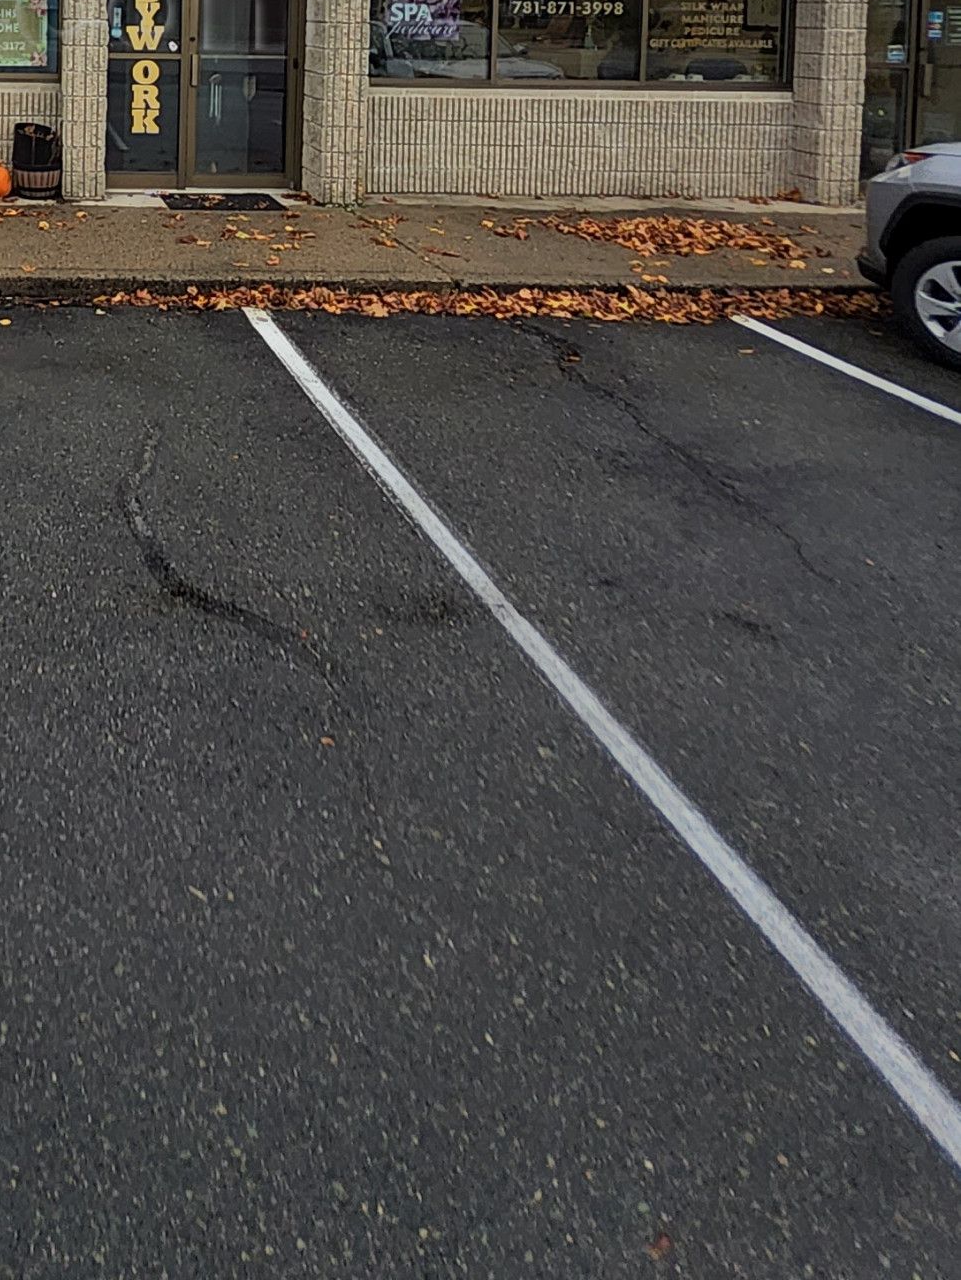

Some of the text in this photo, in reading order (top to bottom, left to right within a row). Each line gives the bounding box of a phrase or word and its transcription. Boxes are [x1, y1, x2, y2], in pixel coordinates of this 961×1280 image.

[512, 0, 624, 15] 781-871-3998
[680, 2, 744, 12] SILK WRAP
[390, 3, 433, 22] SPA
[681, 14, 744, 24] MANICURE
[684, 26, 740, 36] PEDICURE
